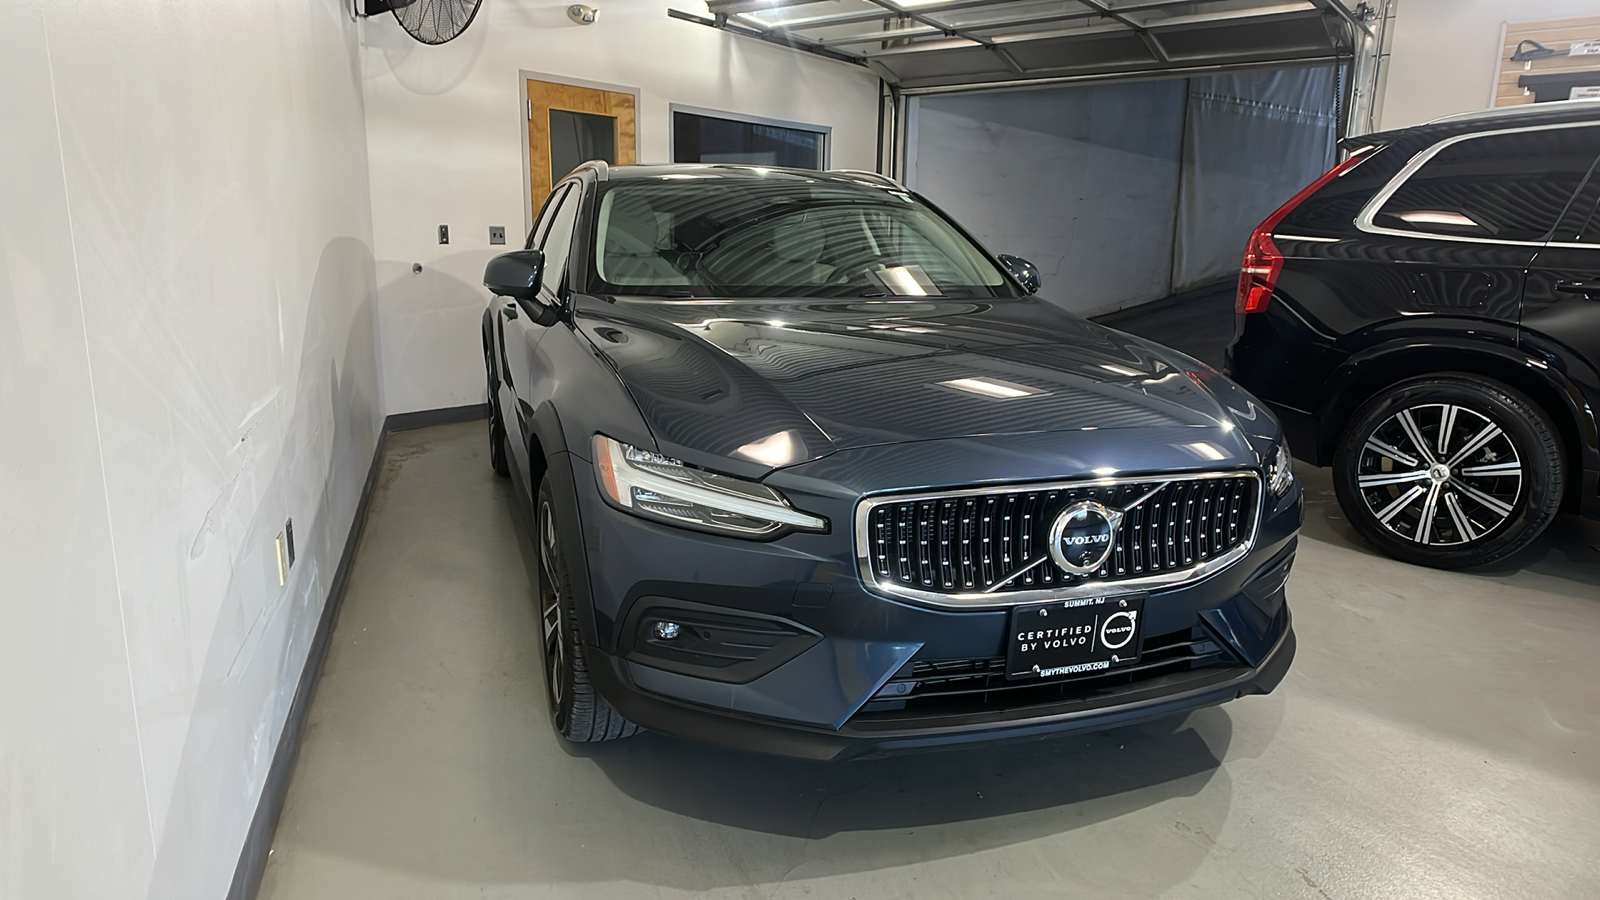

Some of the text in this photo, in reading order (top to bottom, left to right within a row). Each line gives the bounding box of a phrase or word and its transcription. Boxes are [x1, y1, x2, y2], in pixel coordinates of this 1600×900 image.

[1063, 534, 1109, 546] VOLVO
[1095, 597, 1106, 605] NJ
[1017, 625, 1092, 641] CERTIFIED
[1105, 626, 1132, 634] VOLVO
[1021, 636, 1087, 652] BY VOLVO
[1040, 660, 1110, 677] SMYTHEVOLVO.COM
